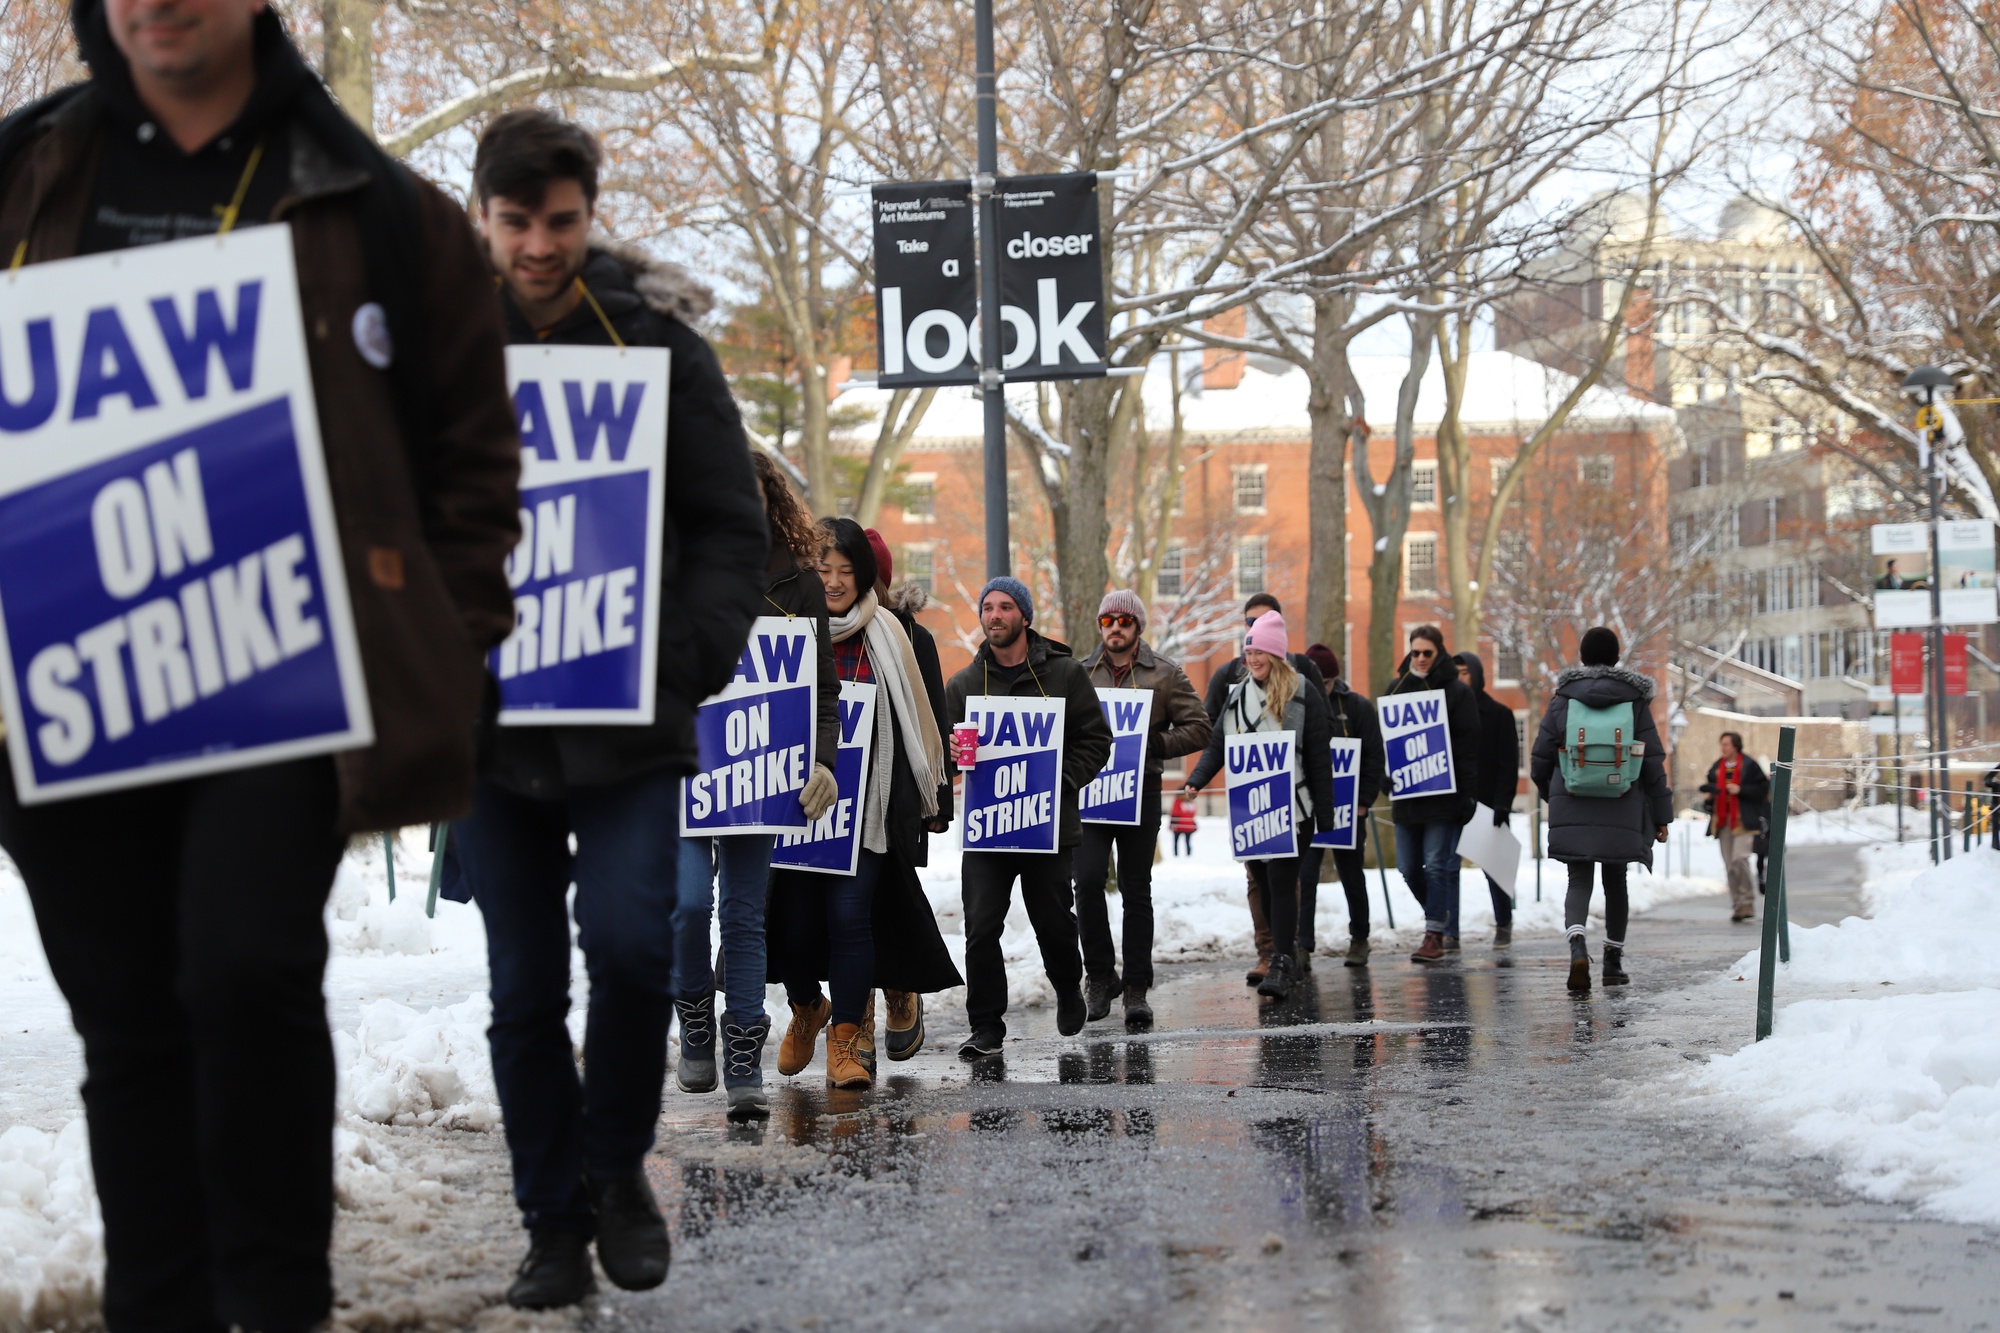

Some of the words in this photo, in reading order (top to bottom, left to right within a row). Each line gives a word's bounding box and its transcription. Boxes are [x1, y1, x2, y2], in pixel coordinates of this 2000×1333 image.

[879, 198, 920, 212] Harvard
[880, 212, 896, 223] Art
[897, 210, 946, 222] Museums
[897, 239, 929, 253] Take
[1007, 231, 1093, 259] closer
[942, 259, 959, 277] a
[0, 279, 263, 433] UAW
[512, 381, 647, 462] AW
[90, 447, 214, 600] ON
[499, 566, 637, 680] RIKE
[26, 533, 322, 766] STRIKE
[728, 635, 806, 683] AW
[725, 702, 770, 756] ON
[970, 712, 1056, 747] UAW
[1383, 699, 1439, 728] UAW
[1229, 742, 1288, 774] UAW
[1405, 732, 1428, 761] ON
[691, 744, 805, 820] STRIKE
[994, 760, 1027, 799] ON
[1079, 769, 1135, 810] TRIKE
[1391, 750, 1448, 793] STRIKE
[967, 790, 1051, 843] STRIKE
[1248, 782, 1271, 815] ON
[1234, 804, 1290, 852] STRIKE
